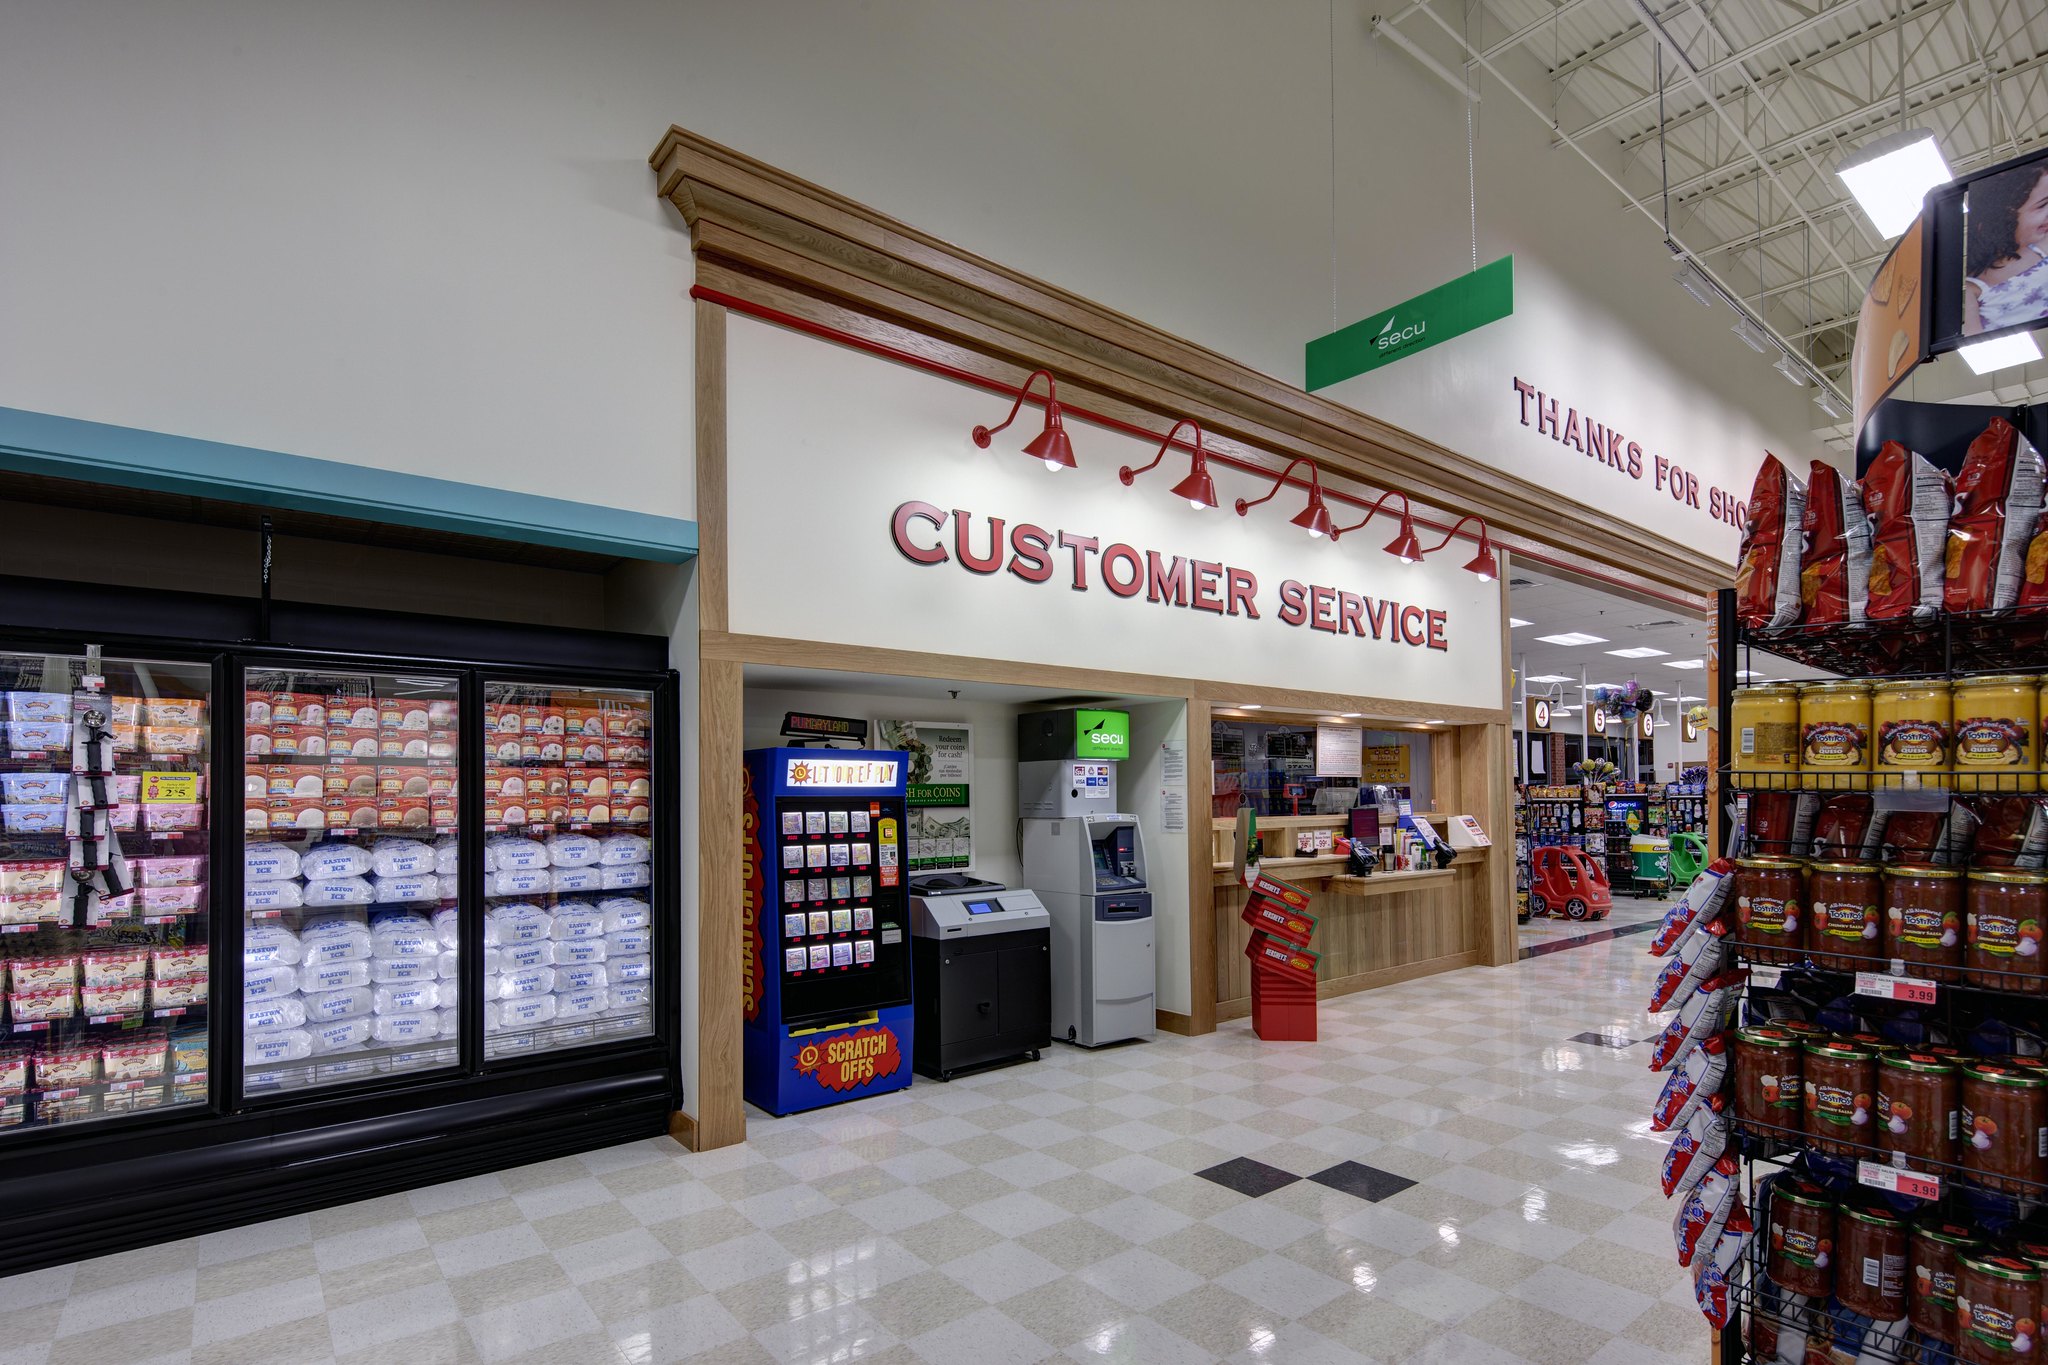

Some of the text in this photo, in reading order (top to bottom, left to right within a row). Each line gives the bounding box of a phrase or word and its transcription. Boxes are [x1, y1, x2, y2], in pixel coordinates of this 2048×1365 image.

[1378, 321, 1425, 349] secu
[1514, 376, 1643, 480] THANKS
[1655, 454, 1699, 509] FOR
[890, 500, 1448, 651] CUSTOMER SERVICE
[1539, 708, 1545, 720] 4
[1597, 714, 1602, 727] 5
[1646, 719, 1650, 731] 6
[1092, 733, 1123, 744] secu
[874, 763, 894, 783] PLAY
[917, 789, 931, 797] FOR
[248, 890, 278, 898] EASTON
[246, 946, 277, 954] EASTON
[321, 943, 351, 952] EASTON
[516, 951, 540, 959] EASTON
[320, 971, 349, 979] EASTON
[328, 977, 342, 985] ICE
[250, 986, 266, 994] ICE
[1908, 989, 1933, 1001] 3.99
[393, 992, 420, 1000] EASTON
[323, 999, 352, 1008] EASTON
[517, 1004, 541, 1012] EASTON
[250, 1009, 281, 1019] EASTON
[323, 1026, 352, 1037] EASTON
[332, 1035, 347, 1043] ICE
[257, 1041, 288, 1049] EASTON
[827, 1033, 887, 1064] SCRATCH
[840, 1057, 874, 1082] OFFS
[1912, 1183, 1937, 1197] 3.99
